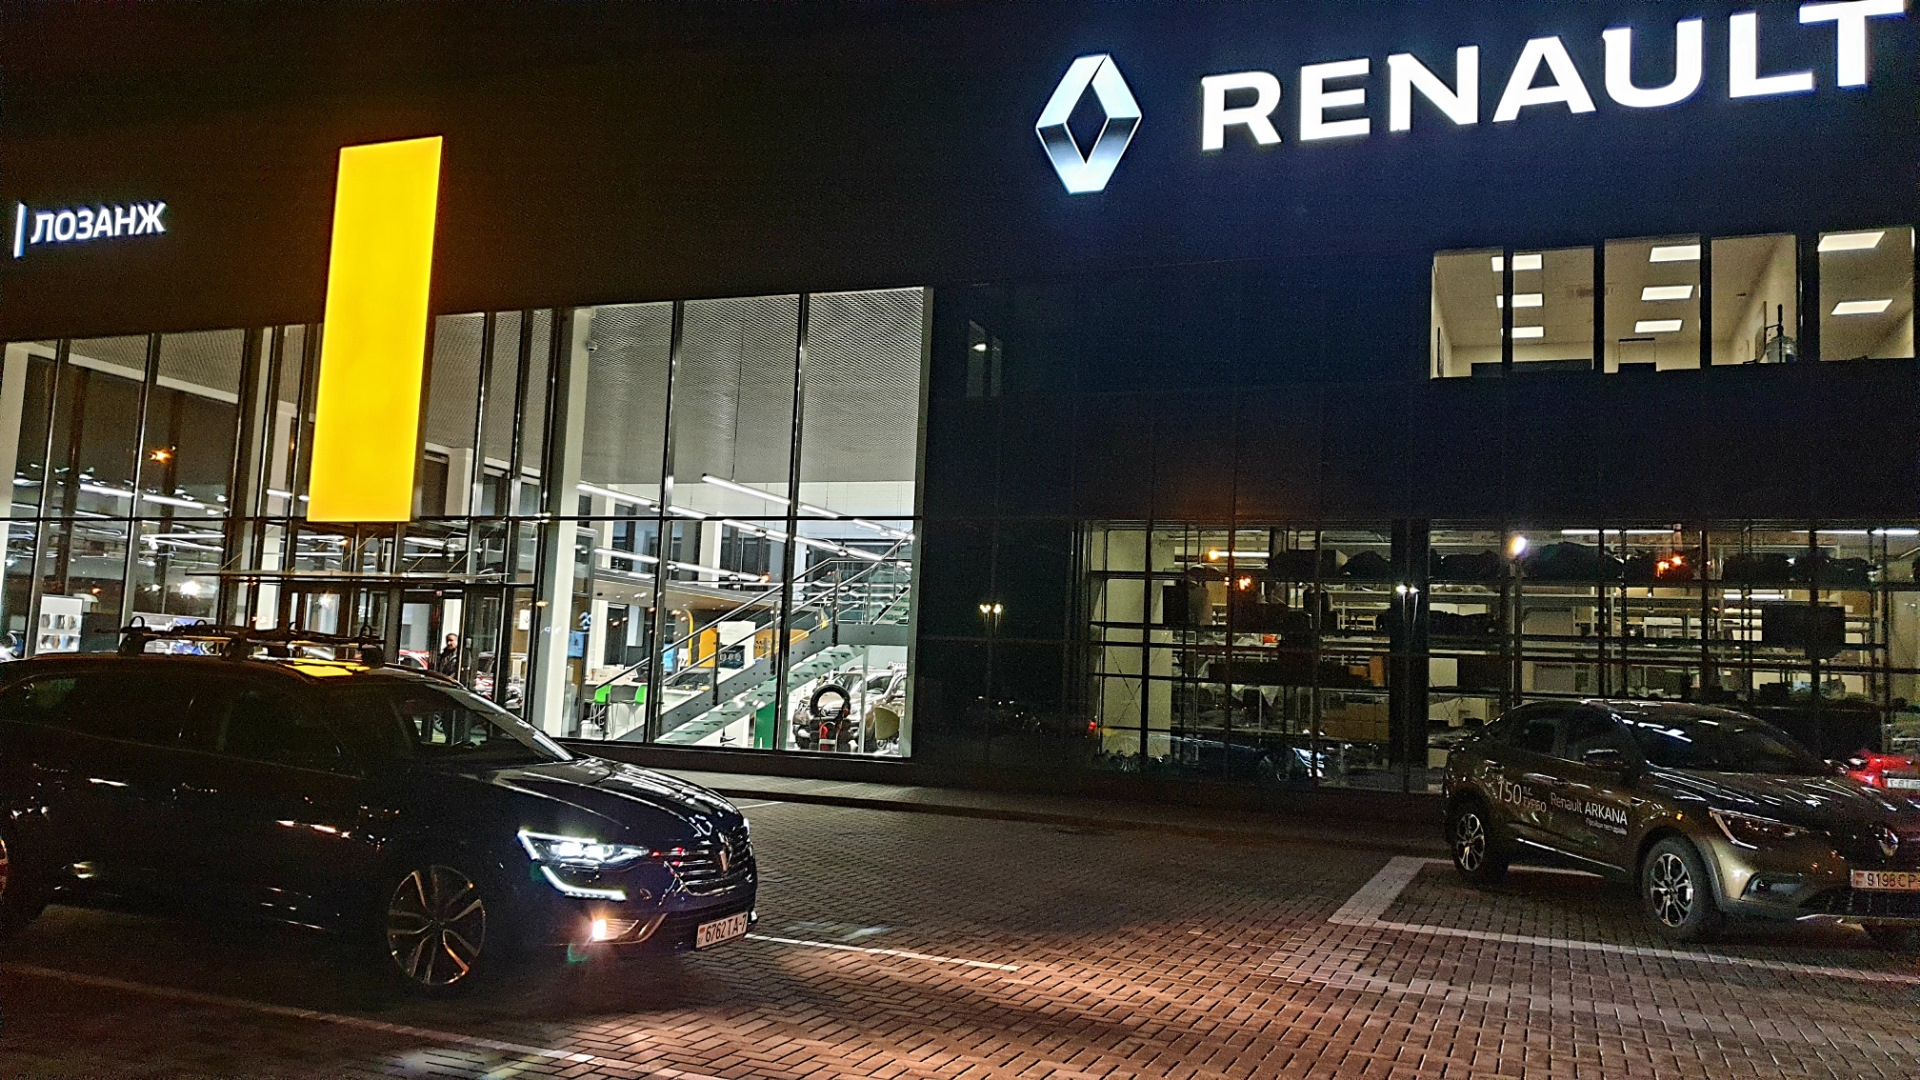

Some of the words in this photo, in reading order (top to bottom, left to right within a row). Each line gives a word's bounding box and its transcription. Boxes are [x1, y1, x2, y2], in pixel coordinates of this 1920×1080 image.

[1200, 0, 1905, 151] RENAULT
[29, 200, 167, 244] ЛОЗАНЖ
[1498, 780, 1522, 804] 150
[1551, 792, 1583, 814] Renault
[1585, 802, 1628, 825] ARKANA
